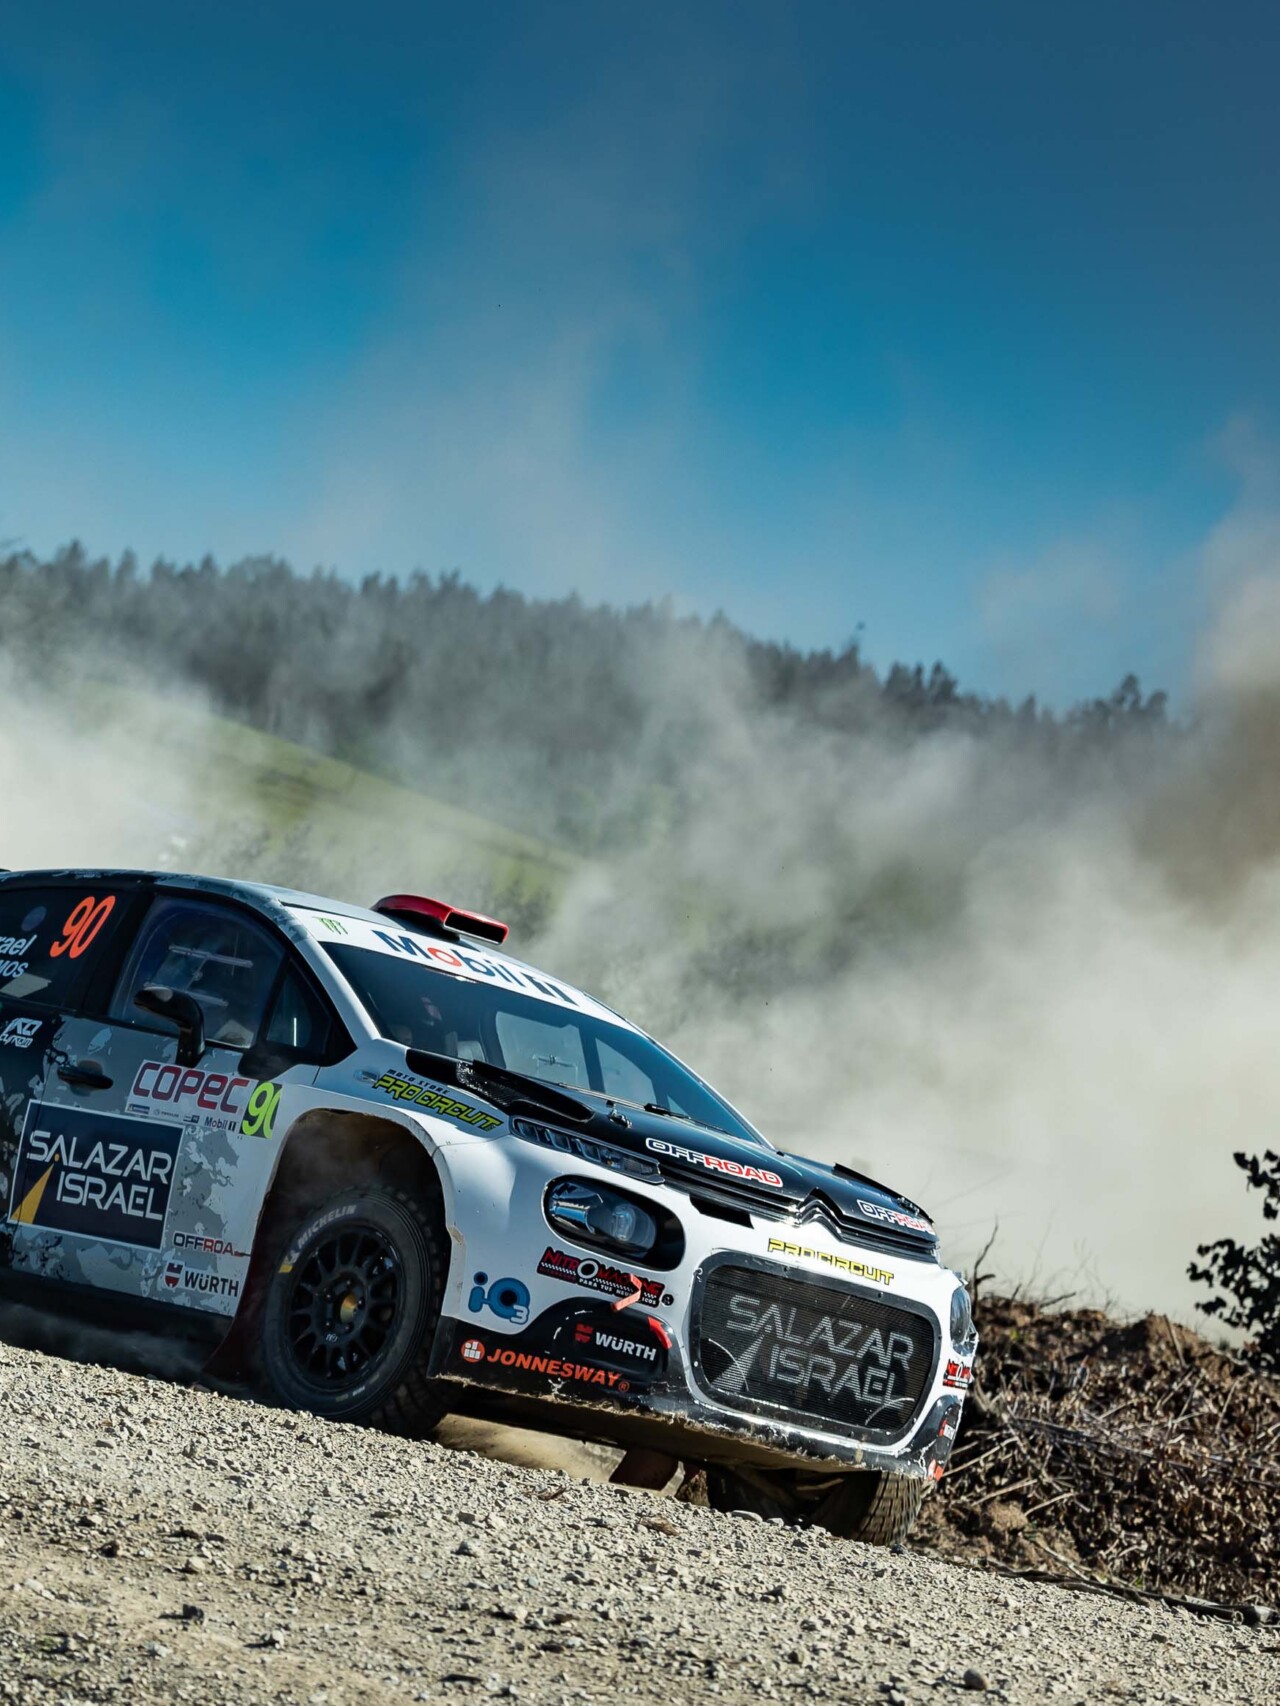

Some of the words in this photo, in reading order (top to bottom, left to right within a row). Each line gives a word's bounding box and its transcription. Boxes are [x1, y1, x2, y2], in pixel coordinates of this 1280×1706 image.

[49, 895, 116, 960] 90
[372, 929, 526, 988] Mobil
[133, 1062, 251, 1114] COPEC
[372, 1074, 423, 1100] PRO
[414, 1090, 504, 1130] CIRCUIT
[387, 1069, 414, 1082] MOTO
[419, 1080, 451, 1095] STORE
[205, 1116, 228, 1130] Mobil
[26, 1130, 172, 1184] SALAZAR
[646, 1138, 783, 1187] OFFROAD
[56, 1172, 163, 1221] ISRAEL
[297, 1204, 357, 1250] MICHELIN
[184, 1271, 239, 1297] WÜRTH
[541, 1247, 665, 1297] NITROMACNE
[578, 1278, 598, 1288] PARA
[600, 1284, 613, 1293] TUS
[768, 1238, 816, 1259] PRO
[816, 1251, 895, 1286] CIRCUIT
[595, 1332, 657, 1361] WÜRTH
[726, 1294, 914, 1371] SALAZAR
[487, 1348, 624, 1387] JONNESWAY
[768, 1345, 905, 1409] ISRAEL
